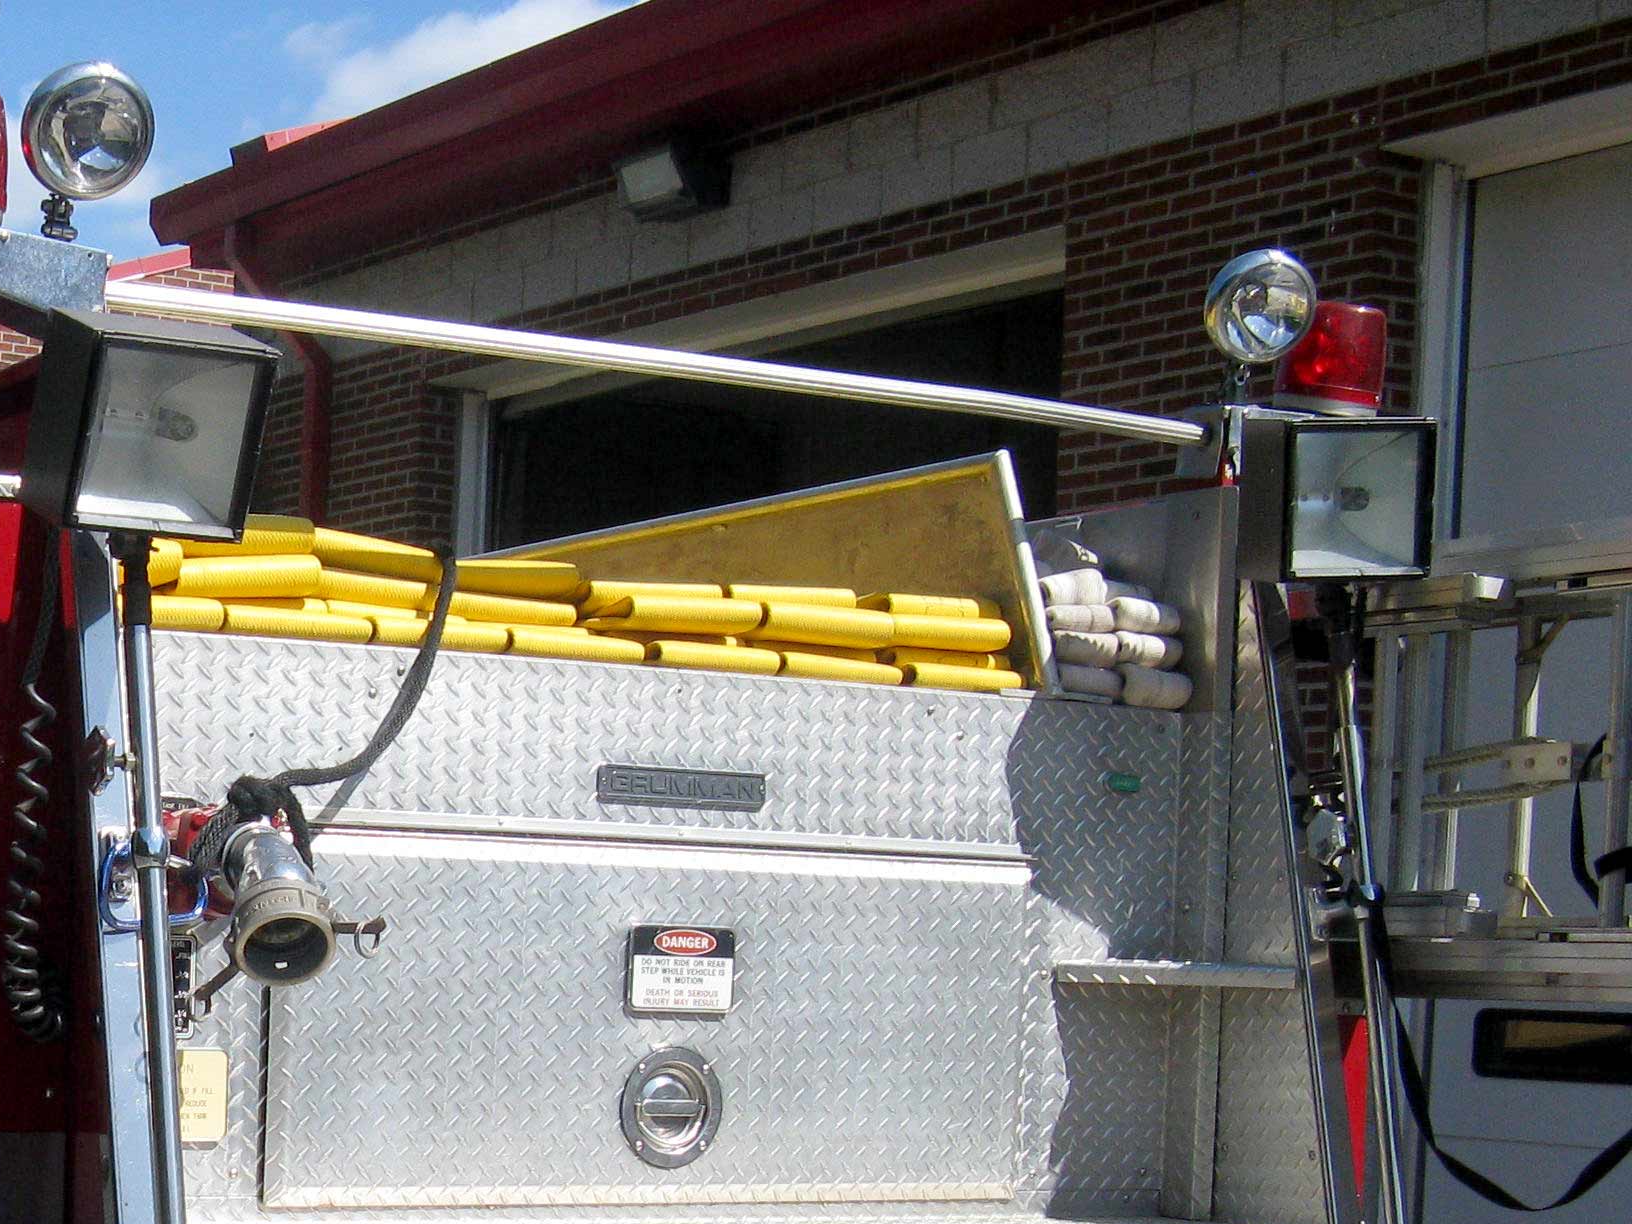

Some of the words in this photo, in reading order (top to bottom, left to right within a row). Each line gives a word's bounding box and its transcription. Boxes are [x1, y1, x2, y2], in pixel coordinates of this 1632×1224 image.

[610, 771, 754, 800] GRUMMAN
[662, 936, 709, 949] DANGER
[673, 959, 690, 967] RIDE
[707, 960, 726, 968] REAR
[641, 966, 659, 974] STEP
[662, 967, 683, 976] WHILE
[687, 968, 716, 976] VEHICLE
[674, 977, 704, 985] MOTION
[645, 988, 670, 996] DEATH
[673, 989, 684, 997] OR
[687, 989, 719, 997] SERIOUS
[673, 998, 688, 1006] MAY
[692, 999, 720, 1007] RESULT
